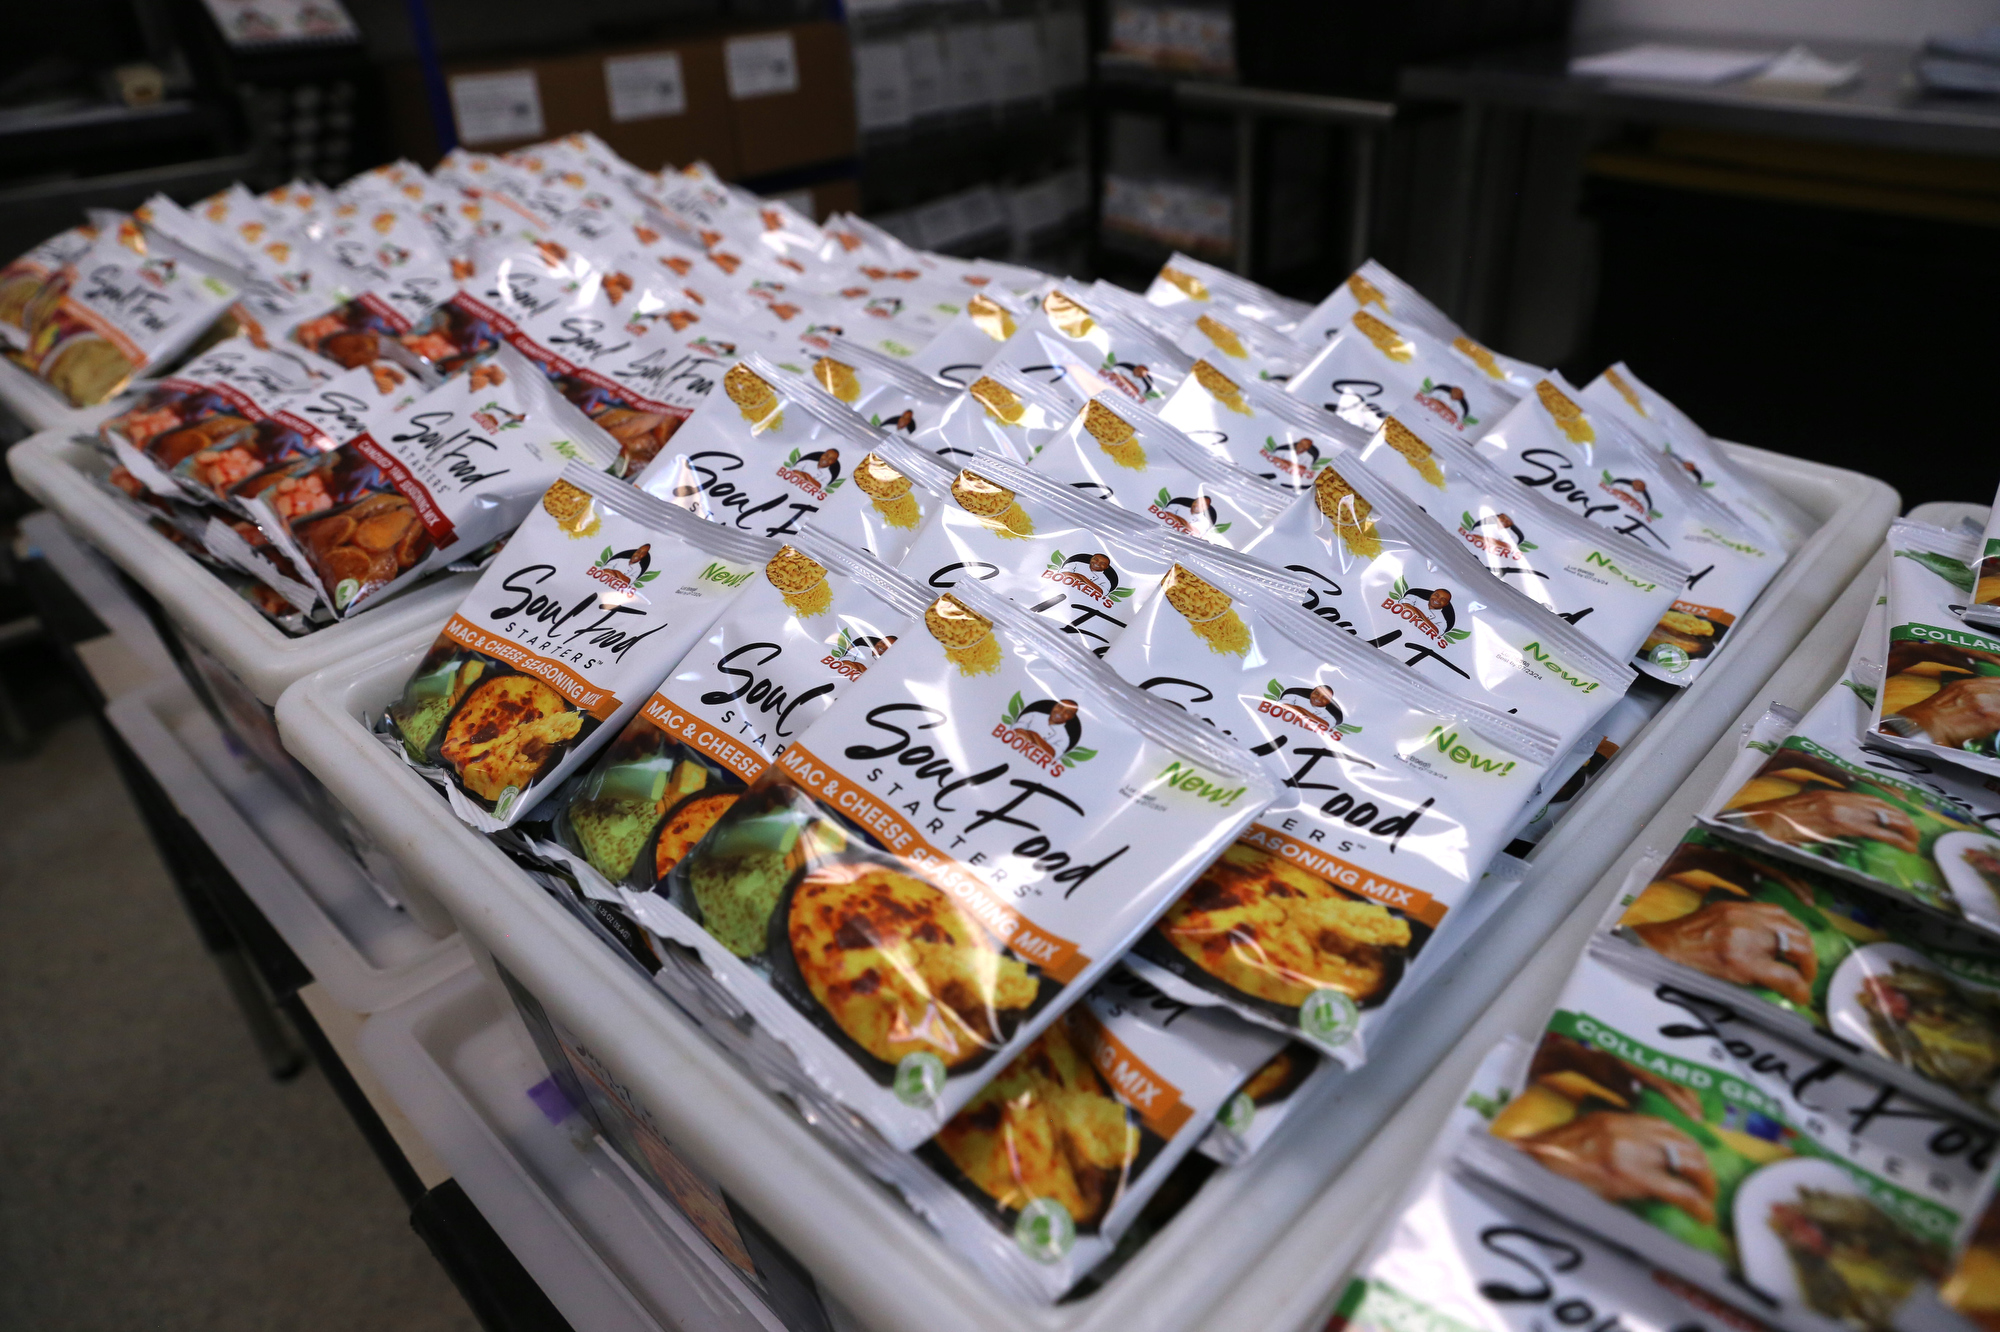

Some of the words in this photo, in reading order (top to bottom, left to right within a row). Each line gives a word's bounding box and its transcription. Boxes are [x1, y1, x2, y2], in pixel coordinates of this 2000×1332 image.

[391, 411, 470, 463] Soul
[433, 436, 510, 492] Food
[672, 451, 789, 530] Soul
[776, 466, 828, 501] BOOKER'S
[423, 509, 440, 526] MIX
[1457, 527, 1523, 561] BOOKER'S
[586, 565, 636, 598] BOOKER'S
[698, 562, 754, 588] New!
[1041, 569, 1114, 609] BOOKER'S
[1585, 551, 1656, 592] New!
[490, 564, 597, 638] Soul
[563, 603, 668, 664] Food
[1381, 598, 1448, 649] BOOKER'S
[1674, 602, 1712, 615] MIX
[447, 620, 474, 644] MAC
[475, 635, 486, 649] &
[485, 638, 526, 666] CHEESE
[520, 654, 585, 700] SEASONING
[579, 690, 604, 707] MIX
[1910, 626, 2000, 656] COLLAR
[701, 642, 835, 737] Soul
[820, 655, 862, 682] BOOK
[1517, 664, 1543, 681] 07/23/24
[1523, 641, 1599, 693] New!
[646, 700, 685, 730] MAC
[682, 722, 698, 740] &
[697, 731, 763, 778] CHEESE
[721, 710, 786, 757] STAR
[1257, 700, 1343, 742] BOOKER'S
[991, 723, 1065, 778] BOOKER'S
[1424, 725, 1516, 777] New!
[1800, 739, 1912, 792] COLLARD
[845, 703, 1009, 812] Soul
[963, 779, 1130, 900] Food
[1155, 761, 1247, 807] New!
[1281, 748, 1435, 853] Food
[782, 749, 826, 786] MAC
[822, 780, 839, 798] &
[839, 790, 912, 849] CHEESE
[908, 847, 1018, 935] SEASONING
[1015, 930, 1060, 961] MIX
[1240, 827, 1360, 885] EASONING
[1361, 881, 1415, 906] MIX
[1576, 1019, 1713, 1089] COLLARD
[1112, 1060, 1162, 1107] MIX
